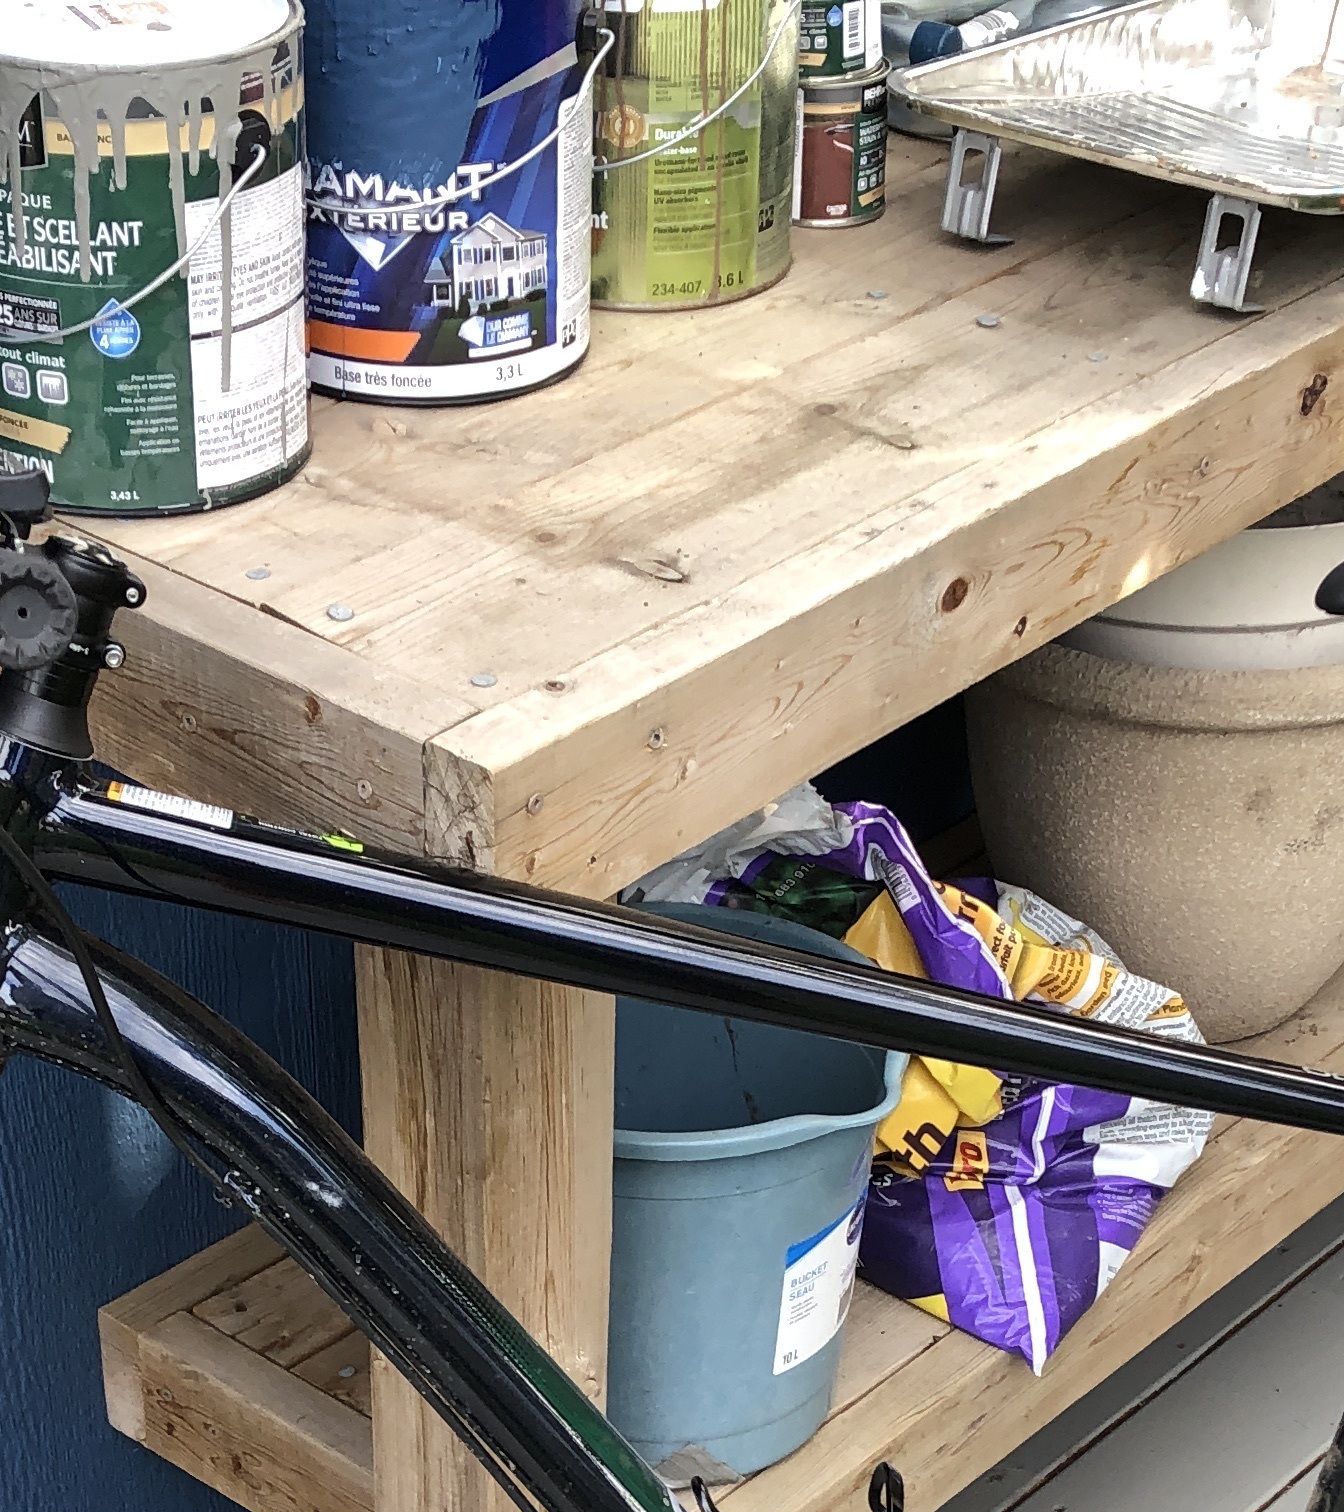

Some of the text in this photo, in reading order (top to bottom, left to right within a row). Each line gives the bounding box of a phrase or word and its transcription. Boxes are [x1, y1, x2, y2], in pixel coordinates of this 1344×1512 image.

[308, 204, 470, 233] XTÉRIEUR
[33, 217, 144, 247] SCELANT
[652, 280, 702, 297] 234-407
[738, 270, 745, 284] L
[14, 307, 35, 322] ANS
[36, 311, 58, 325] SUR
[100, 334, 109, 349] 4
[25, 351, 66, 369] climat
[334, 365, 433, 388] Base très foncée
[495, 362, 524, 383] 3,3 L
[132, 490, 141, 501] L
[790, 1261, 828, 1288] BUCKET
[789, 1282, 815, 1302] SEAU
[782, 1349, 799, 1366] 10 L
